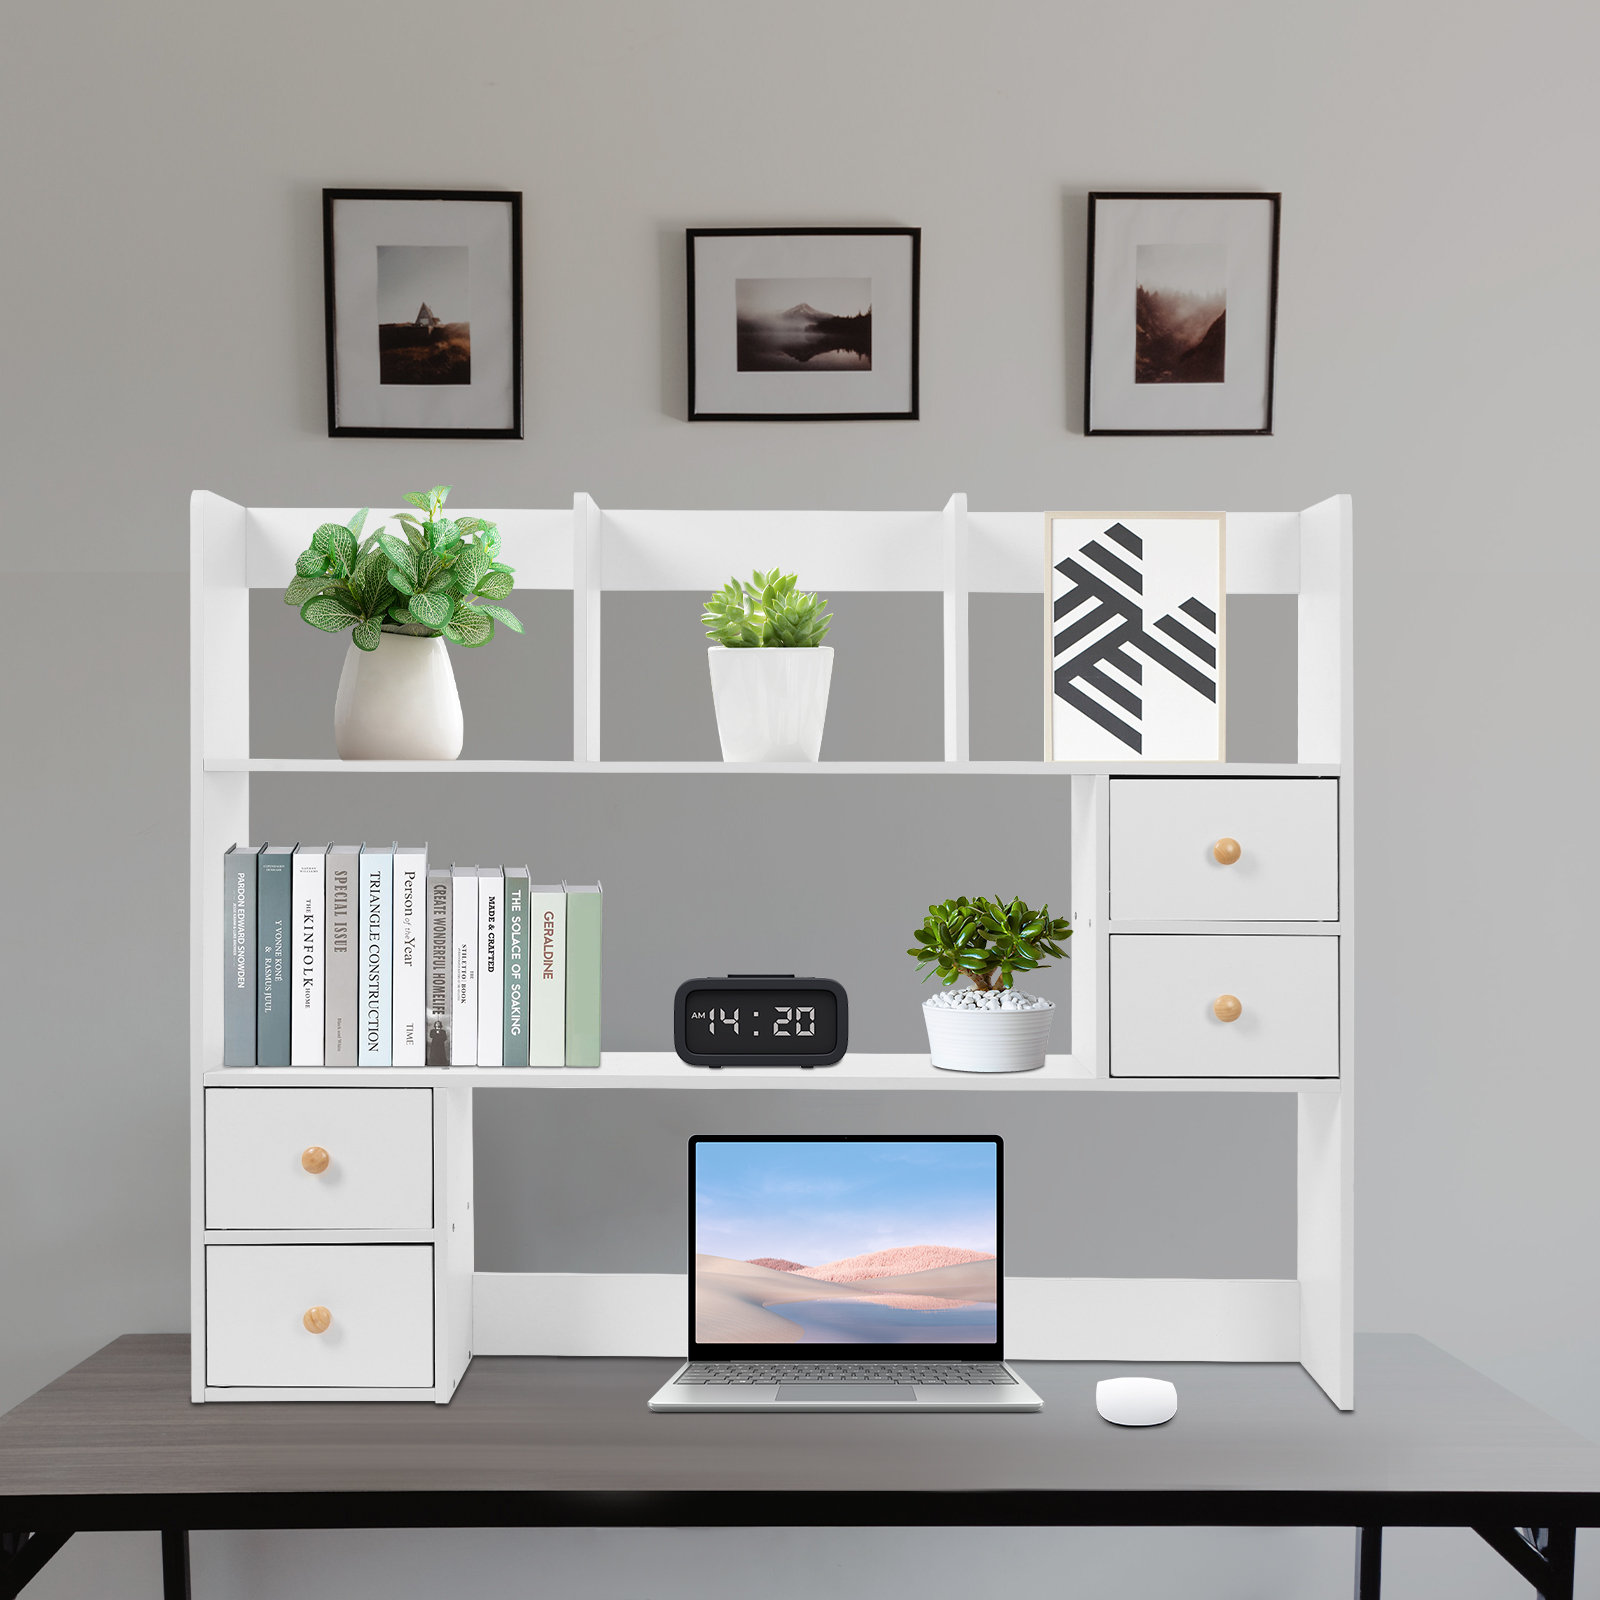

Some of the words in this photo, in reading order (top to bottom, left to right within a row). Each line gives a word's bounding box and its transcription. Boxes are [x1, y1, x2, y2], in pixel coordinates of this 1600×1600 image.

[237, 872, 246, 907] PARDON
[334, 870, 348, 916] SPECIAL
[368, 870, 380, 941] TRIANGLE
[404, 871, 416, 916] Person
[433, 884, 447, 915] CREATE
[512, 890, 521, 912] THE
[237, 908, 246, 944] EDWARD
[334, 922, 348, 953] ISSUE
[403, 918, 412, 926] of
[512, 916, 521, 960] SOLACE
[303, 914, 314, 988] KINFOLK
[404, 937, 416, 966] Year
[432, 917, 447, 970] WONDERFUL
[542, 911, 554, 980] GERALDINE
[237, 946, 246, 988] SNOWDEN
[274, 958, 282, 982] KONÉ
[511, 964, 521, 979] OF
[264, 992, 272, 1014] JUUL
[368, 944, 380, 1052] CONSTRUCTION
[432, 973, 446, 1015] HOMELIFE
[511, 984, 521, 1036] SOAKING
[406, 1022, 414, 1046] TIME
